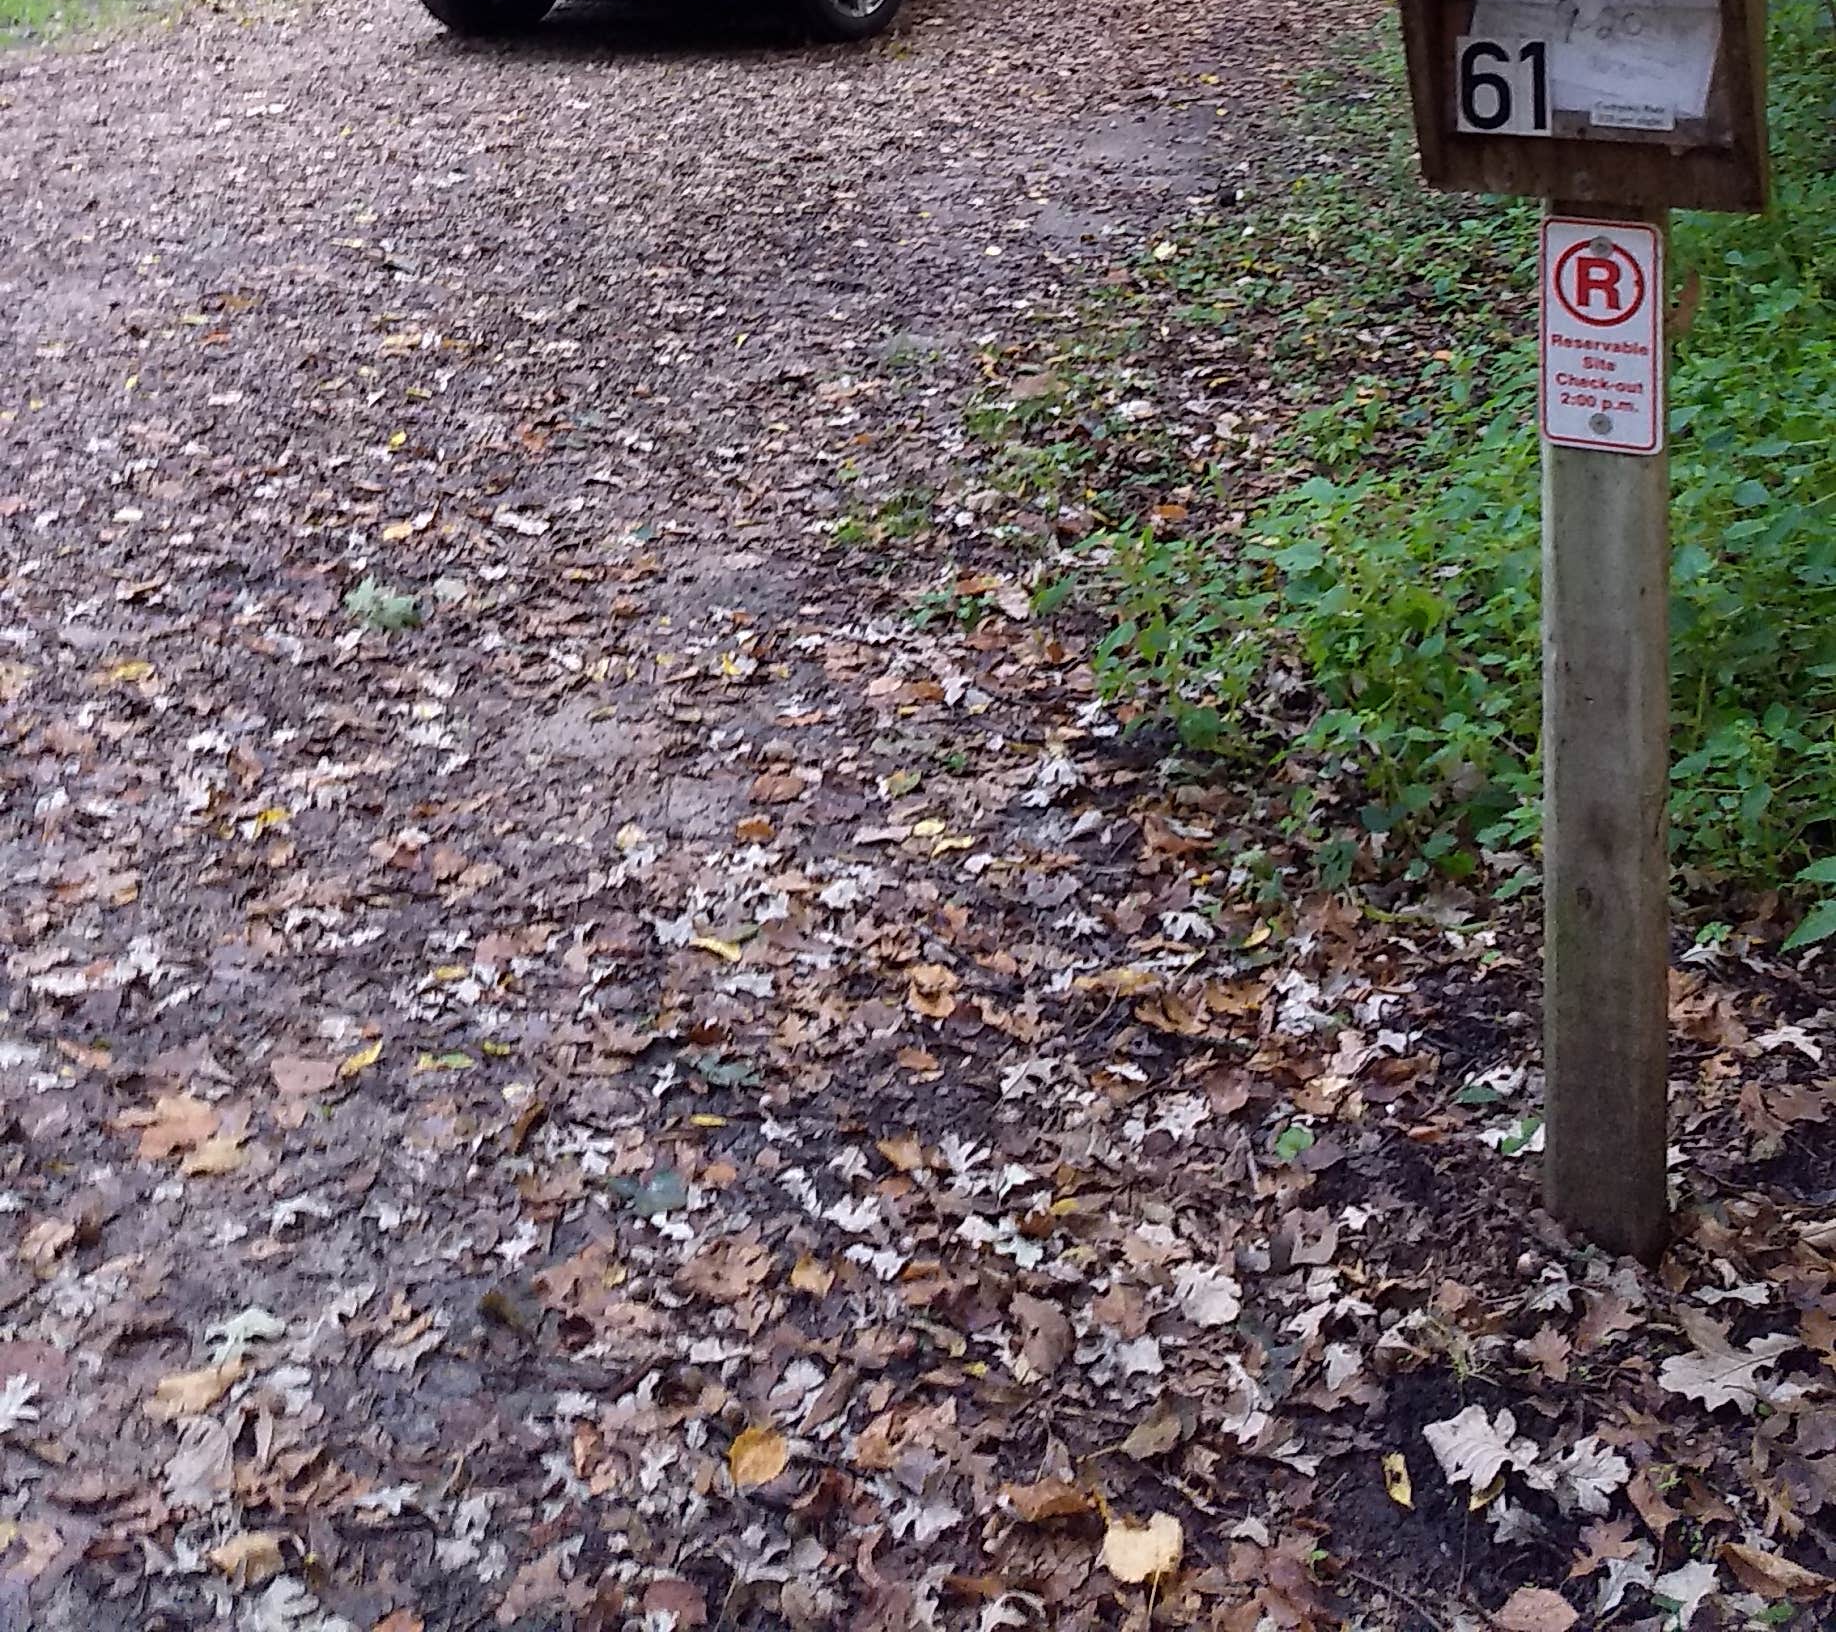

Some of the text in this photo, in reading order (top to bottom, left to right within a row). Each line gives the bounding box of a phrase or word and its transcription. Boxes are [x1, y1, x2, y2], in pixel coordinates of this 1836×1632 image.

[1461, 40, 1547, 130] 61
[1575, 255, 1622, 311] R
[1551, 333, 1649, 356] Reservable
[1582, 356, 1616, 372] Site
[1555, 372, 1643, 394] Check-out
[1560, 392, 1639, 413] 2:00 p.m.
